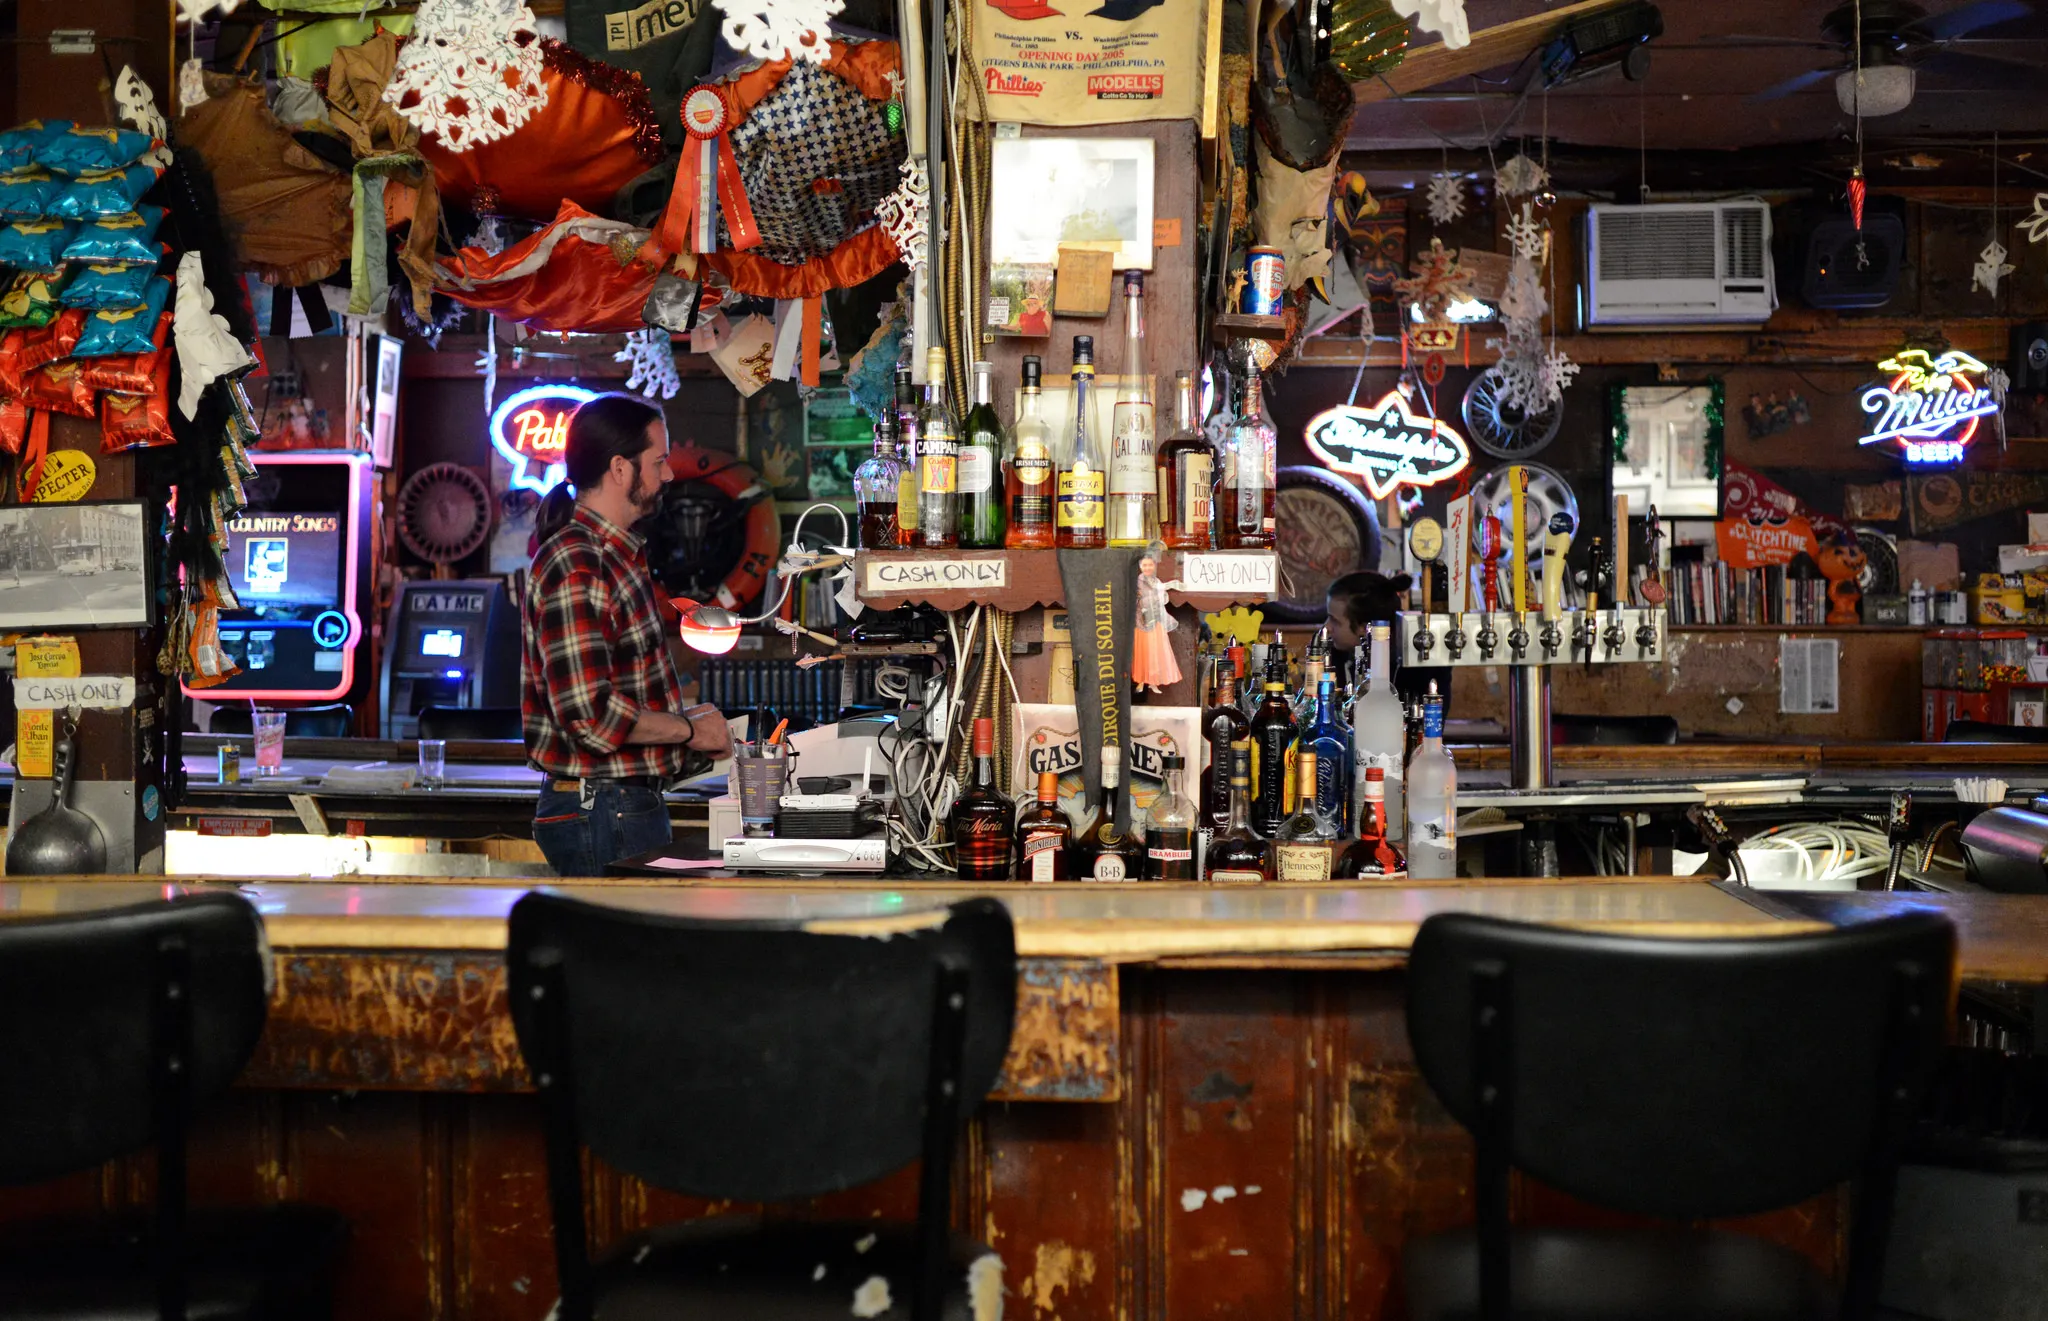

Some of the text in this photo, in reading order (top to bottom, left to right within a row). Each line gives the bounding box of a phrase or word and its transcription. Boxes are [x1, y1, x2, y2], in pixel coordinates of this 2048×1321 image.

[609, 22, 625, 42] TPI
[994, 32, 1032, 42] Philadelphia
[1093, 35, 1128, 43] Washington
[1101, 42, 1130, 50] Inaugural
[1018, 49, 1125, 62] OPENING DAY 2005
[981, 59, 1020, 68] CITIZENS
[1022, 61, 1047, 69] BANK
[1153, 59, 1165, 67] PA
[984, 67, 1043, 94] Phillies
[1089, 76, 1161, 90] MODELL'S
[1861, 387, 1990, 436] Miller
[513, 410, 568, 451] Pab
[916, 439, 958, 456] CAMPAR
[1906, 443, 1964, 463] BEER
[1033, 459, 1049, 467] MIST
[32, 463, 92, 502] SPECTER
[1062, 480, 1099, 489] METAXA
[229, 517, 291, 533] COUNTRY
[879, 561, 1002, 583] CASH ONLY
[1190, 557, 1274, 585] CASH ONLY
[29, 651, 66, 662] Jose Cuervo
[1094, 581, 1119, 747] CIRQUE DU SOLEIL
[28, 683, 123, 702] CASH ONLY
[22, 719, 49, 731] Monte
[21, 730, 48, 741] Alban
[1030, 741, 1081, 774] GAS
[204, 819, 266, 829] EMPLOYEES MUST
[968, 815, 1003, 833] Maria
[1149, 849, 1191, 858] DRAMBUIE
[1100, 866, 1120, 878] B&B
[1283, 860, 1323, 872] Hennessy
